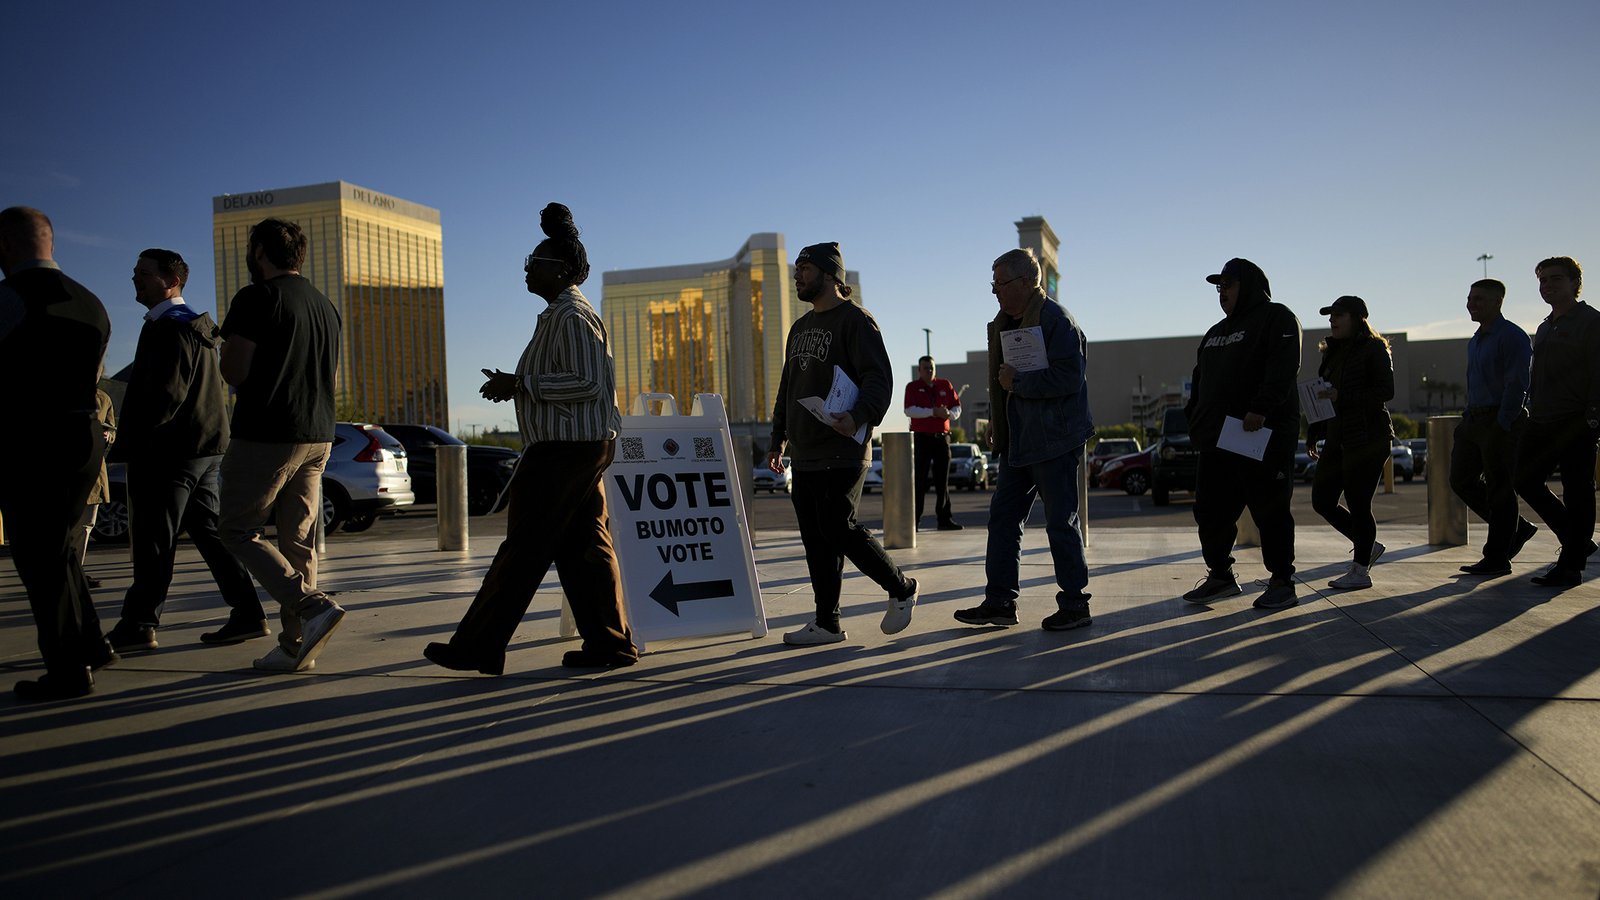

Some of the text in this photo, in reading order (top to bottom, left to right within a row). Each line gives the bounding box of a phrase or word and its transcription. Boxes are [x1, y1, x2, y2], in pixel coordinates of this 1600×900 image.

[223, 193, 274, 210] DELANO
[353, 188, 395, 209] DELANO
[613, 472, 731, 511] VOTE
[636, 517, 724, 539] BUMOTO
[657, 542, 714, 563] VOTE
